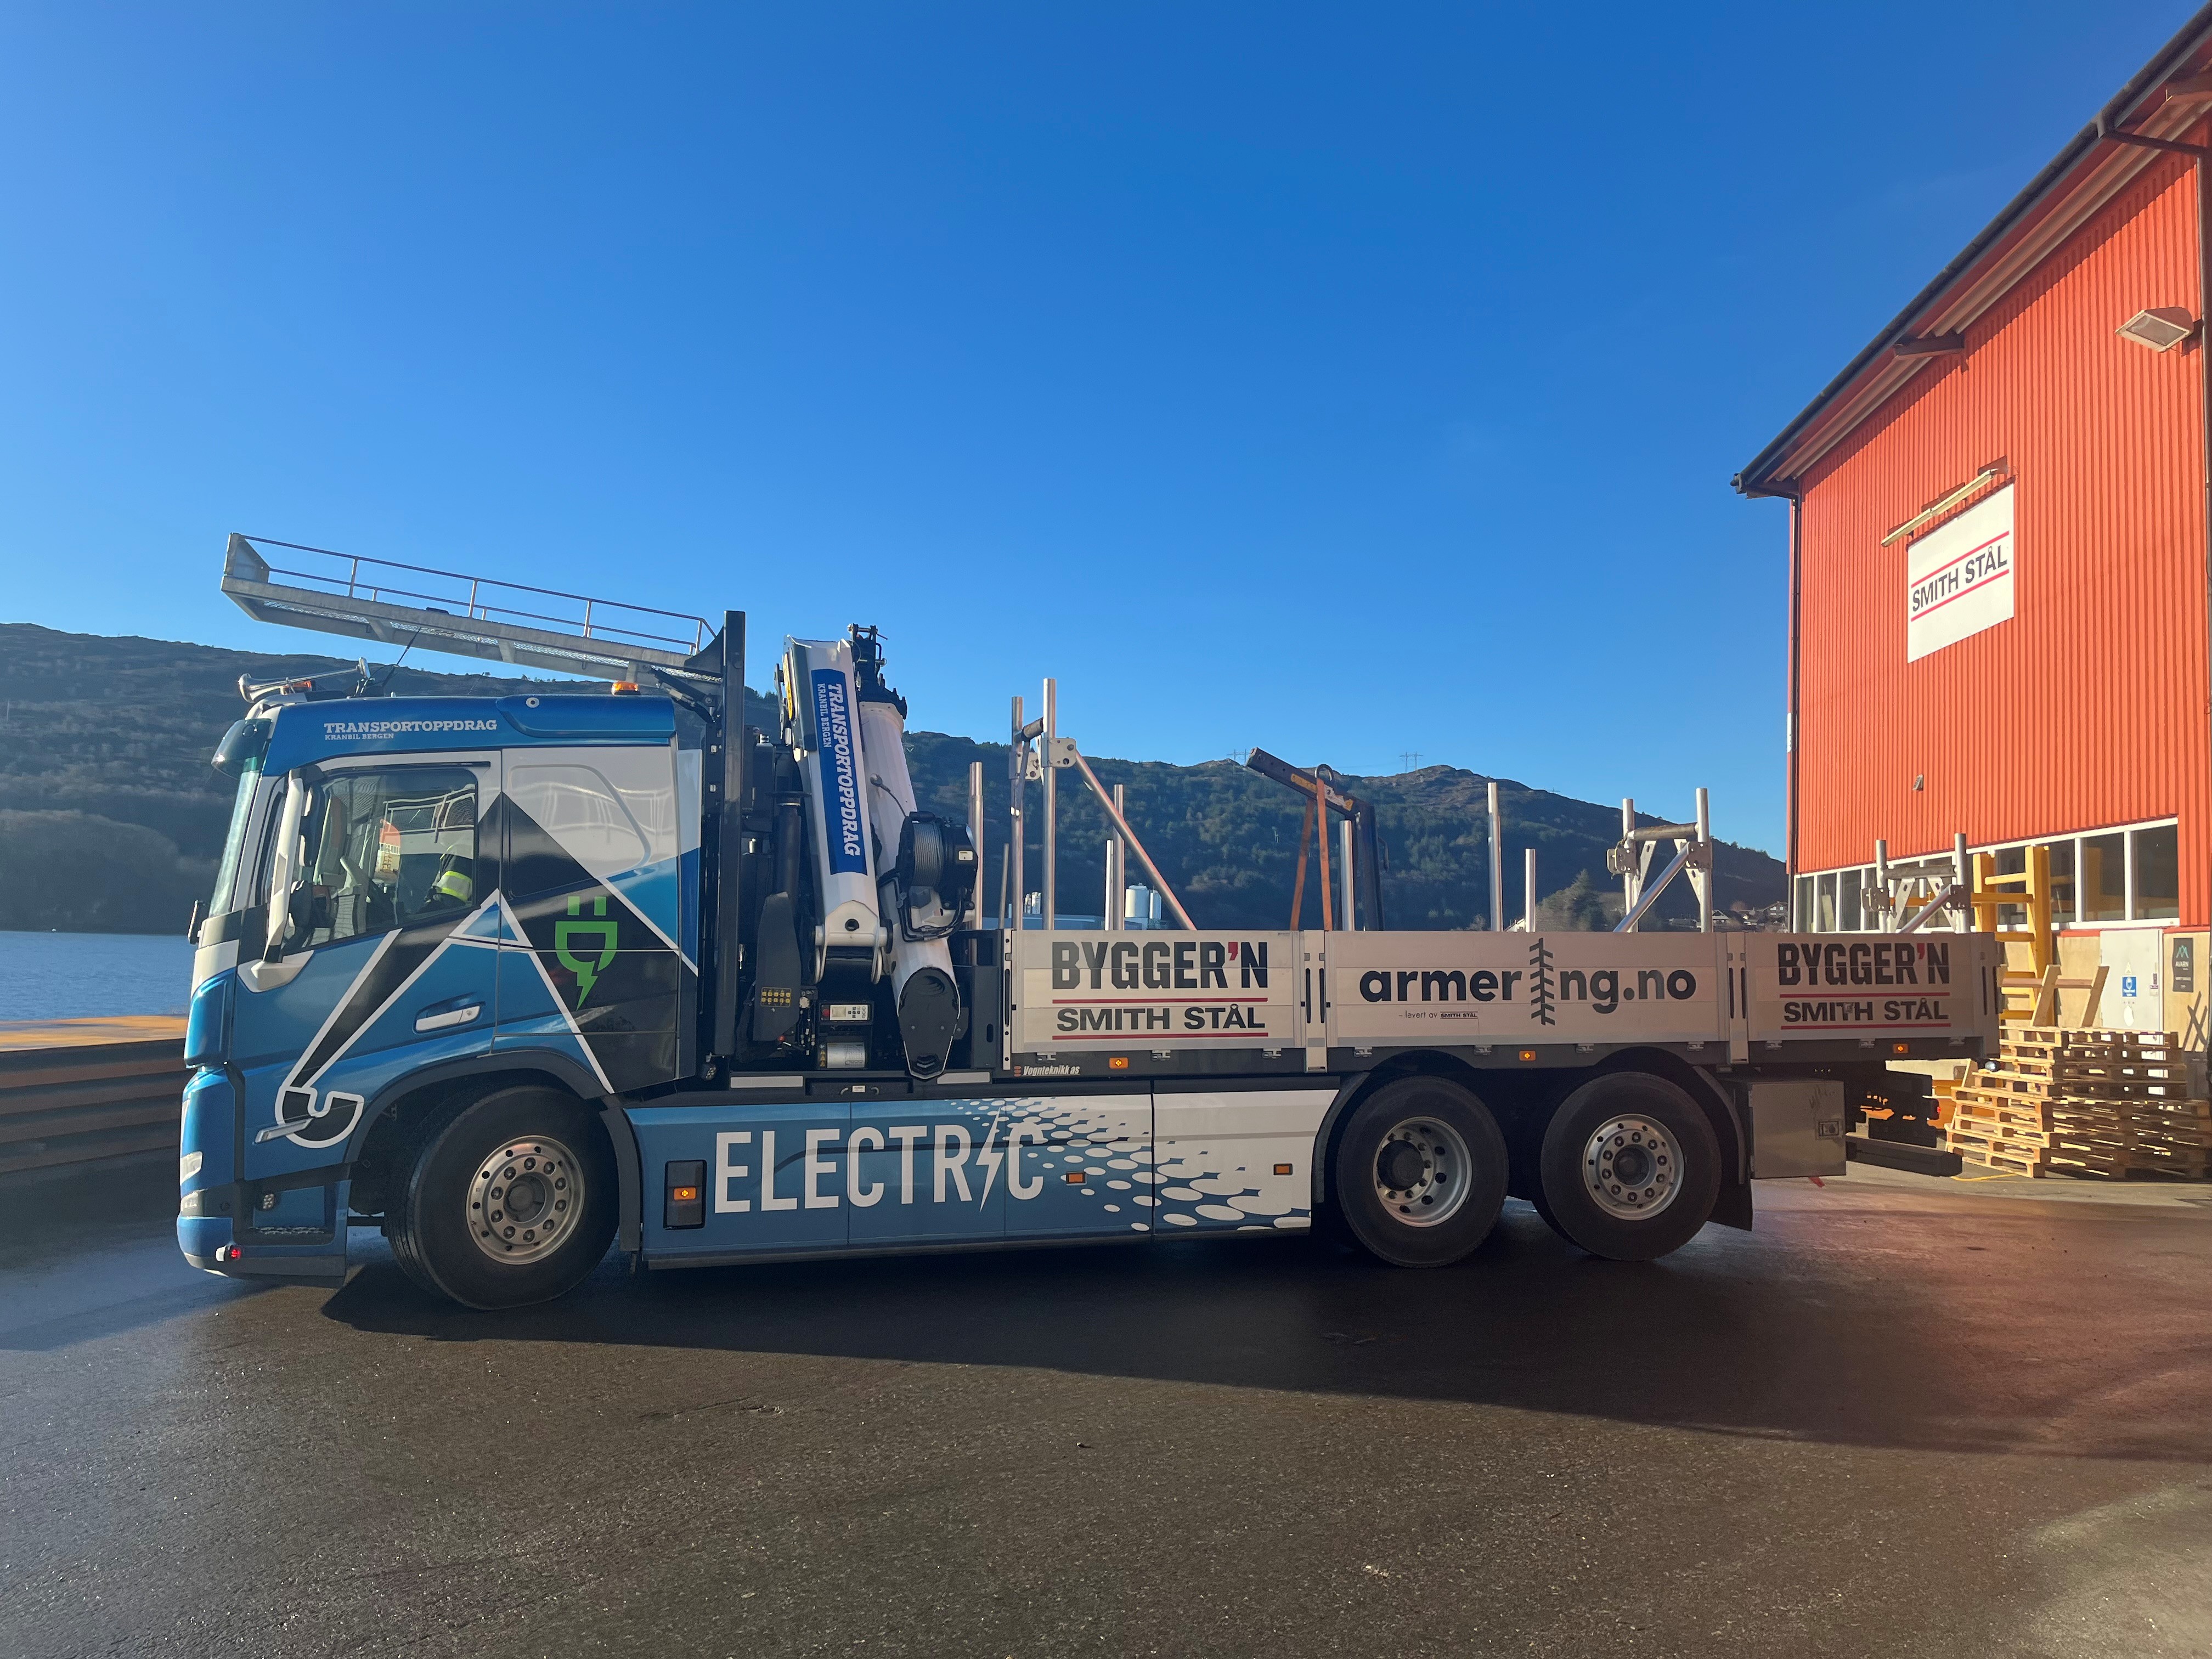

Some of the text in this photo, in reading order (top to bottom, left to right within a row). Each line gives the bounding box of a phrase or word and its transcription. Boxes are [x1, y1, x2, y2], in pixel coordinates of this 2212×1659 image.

[1912, 545, 2007, 612] SMITH STÅL
[324, 720, 497, 733] TRANSPORTOPPDRAG
[817, 684, 832, 748] KRANBIL BERGEN
[828, 683, 860, 856] TRANSPORTOPPDRAG
[1052, 941, 1268, 989] BYGGER'N
[1778, 943, 1950, 985] BYGGER'N
[1057, 1003, 1265, 1031] SMITH STÅL
[1405, 1010, 1426, 1018] levert
[1784, 997, 1949, 1022] SMITH STÅL
[1023, 1065, 1080, 1076] Vognteknikk as
